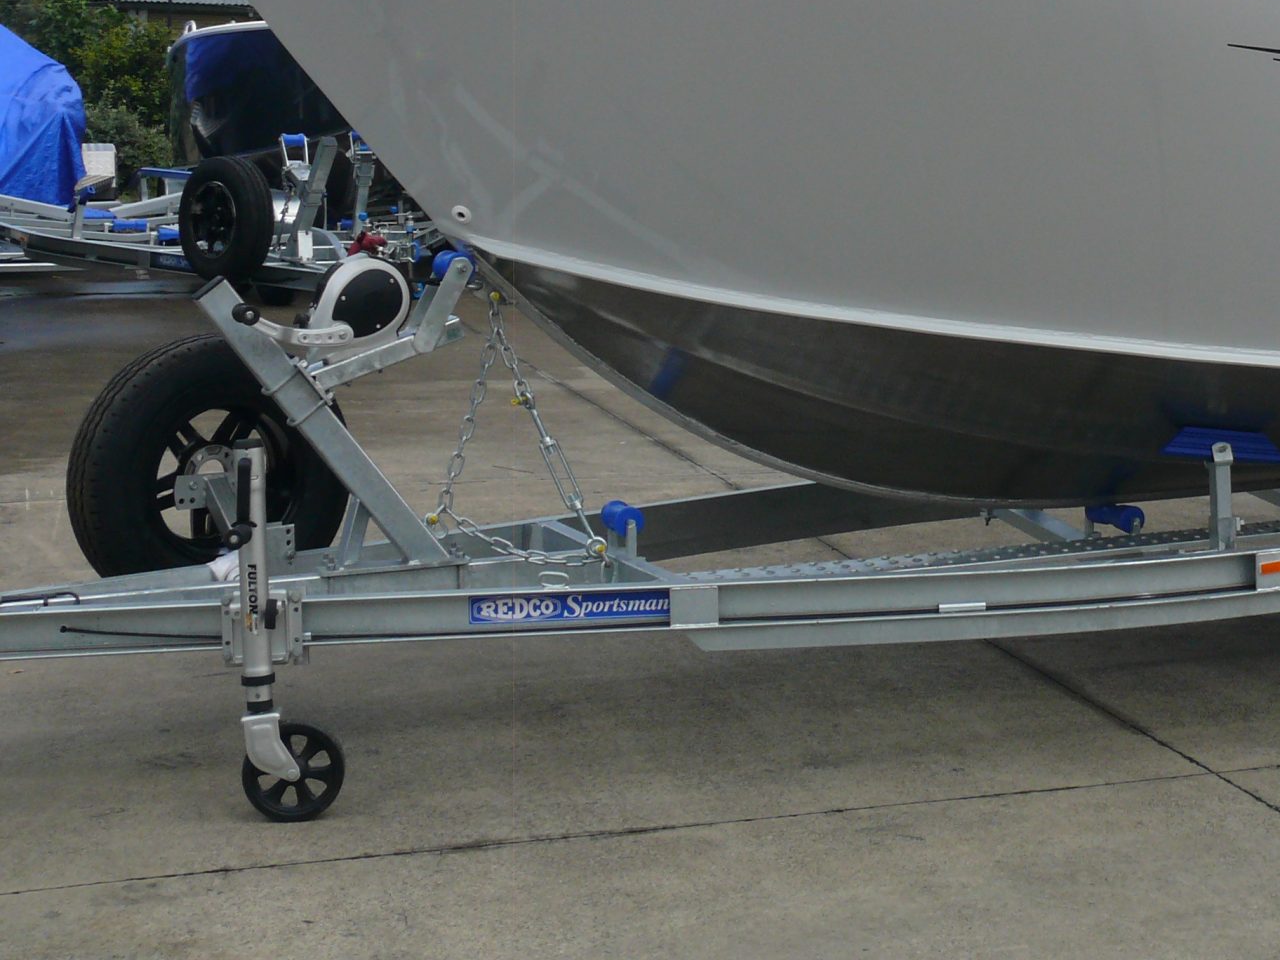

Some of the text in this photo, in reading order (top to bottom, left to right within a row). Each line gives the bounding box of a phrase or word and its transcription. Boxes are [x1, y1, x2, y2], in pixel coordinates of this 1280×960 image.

[247, 564, 258, 614] FULTON
[480, 594, 669, 620] REDCO Sportsman
